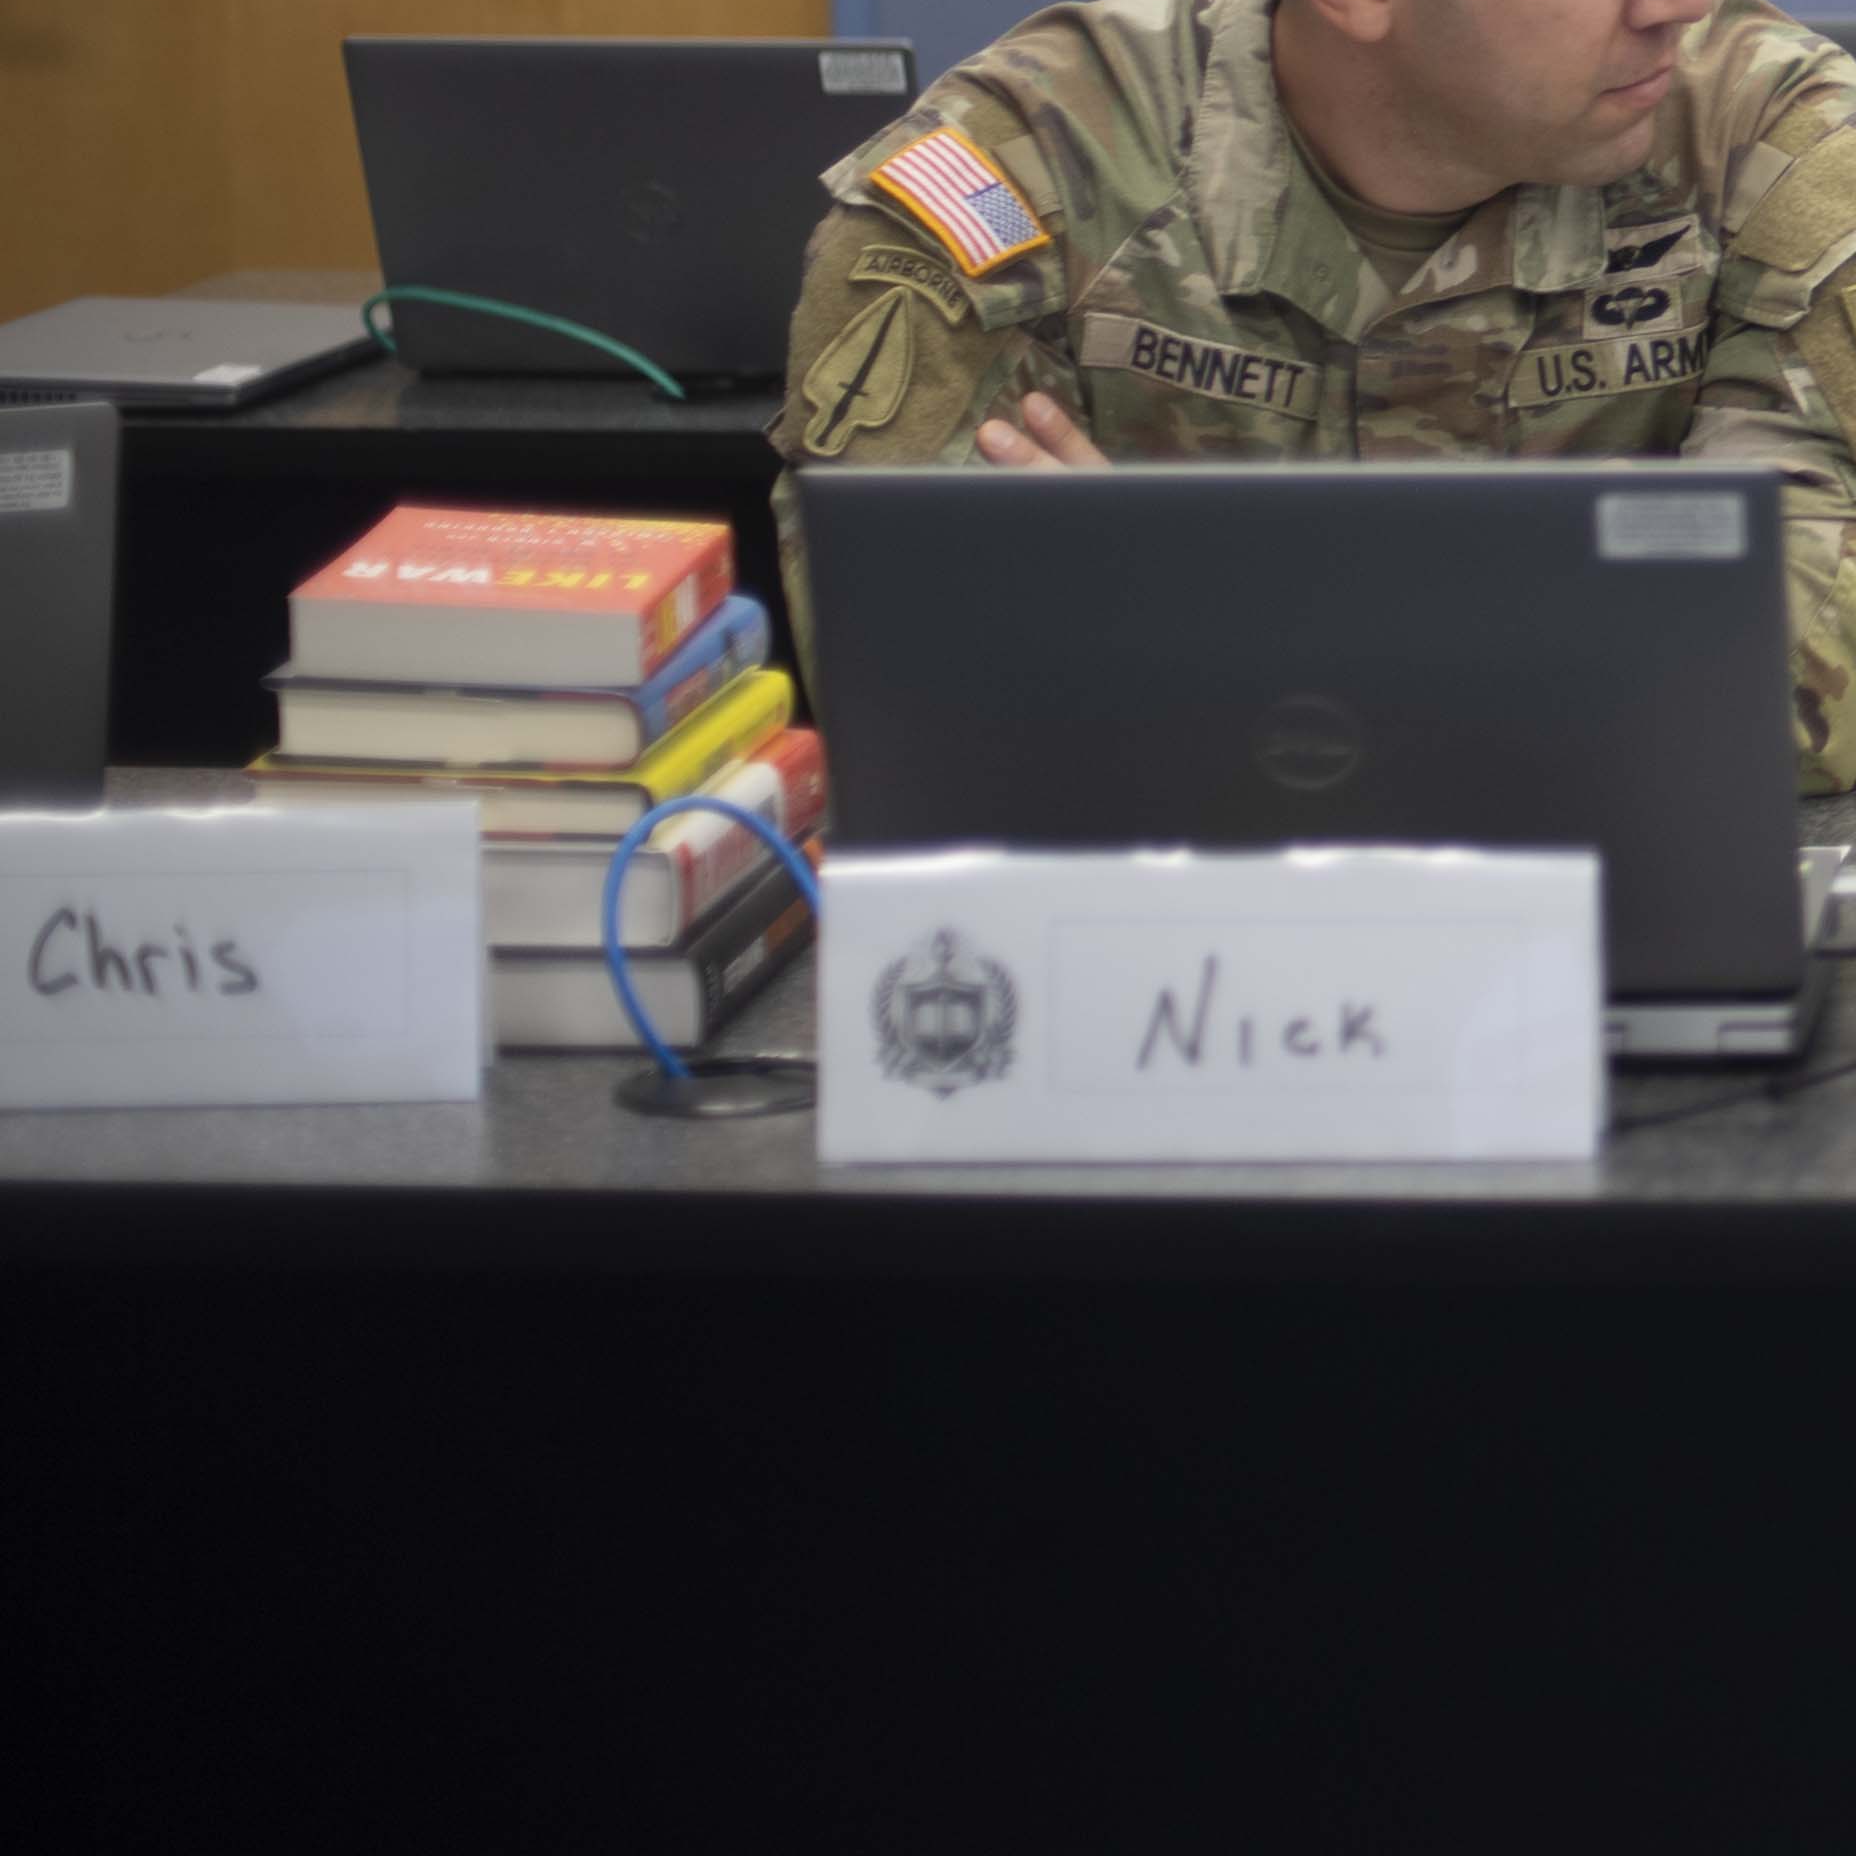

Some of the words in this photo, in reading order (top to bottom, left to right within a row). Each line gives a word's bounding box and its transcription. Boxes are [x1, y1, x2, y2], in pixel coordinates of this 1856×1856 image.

[863, 253, 965, 308] AIRBORNE
[1131, 326, 1305, 408] BENNETT
[1537, 349, 1607, 397] U.S.
[1624, 334, 1708, 386] ARM
[27, 905, 262, 997] Chris
